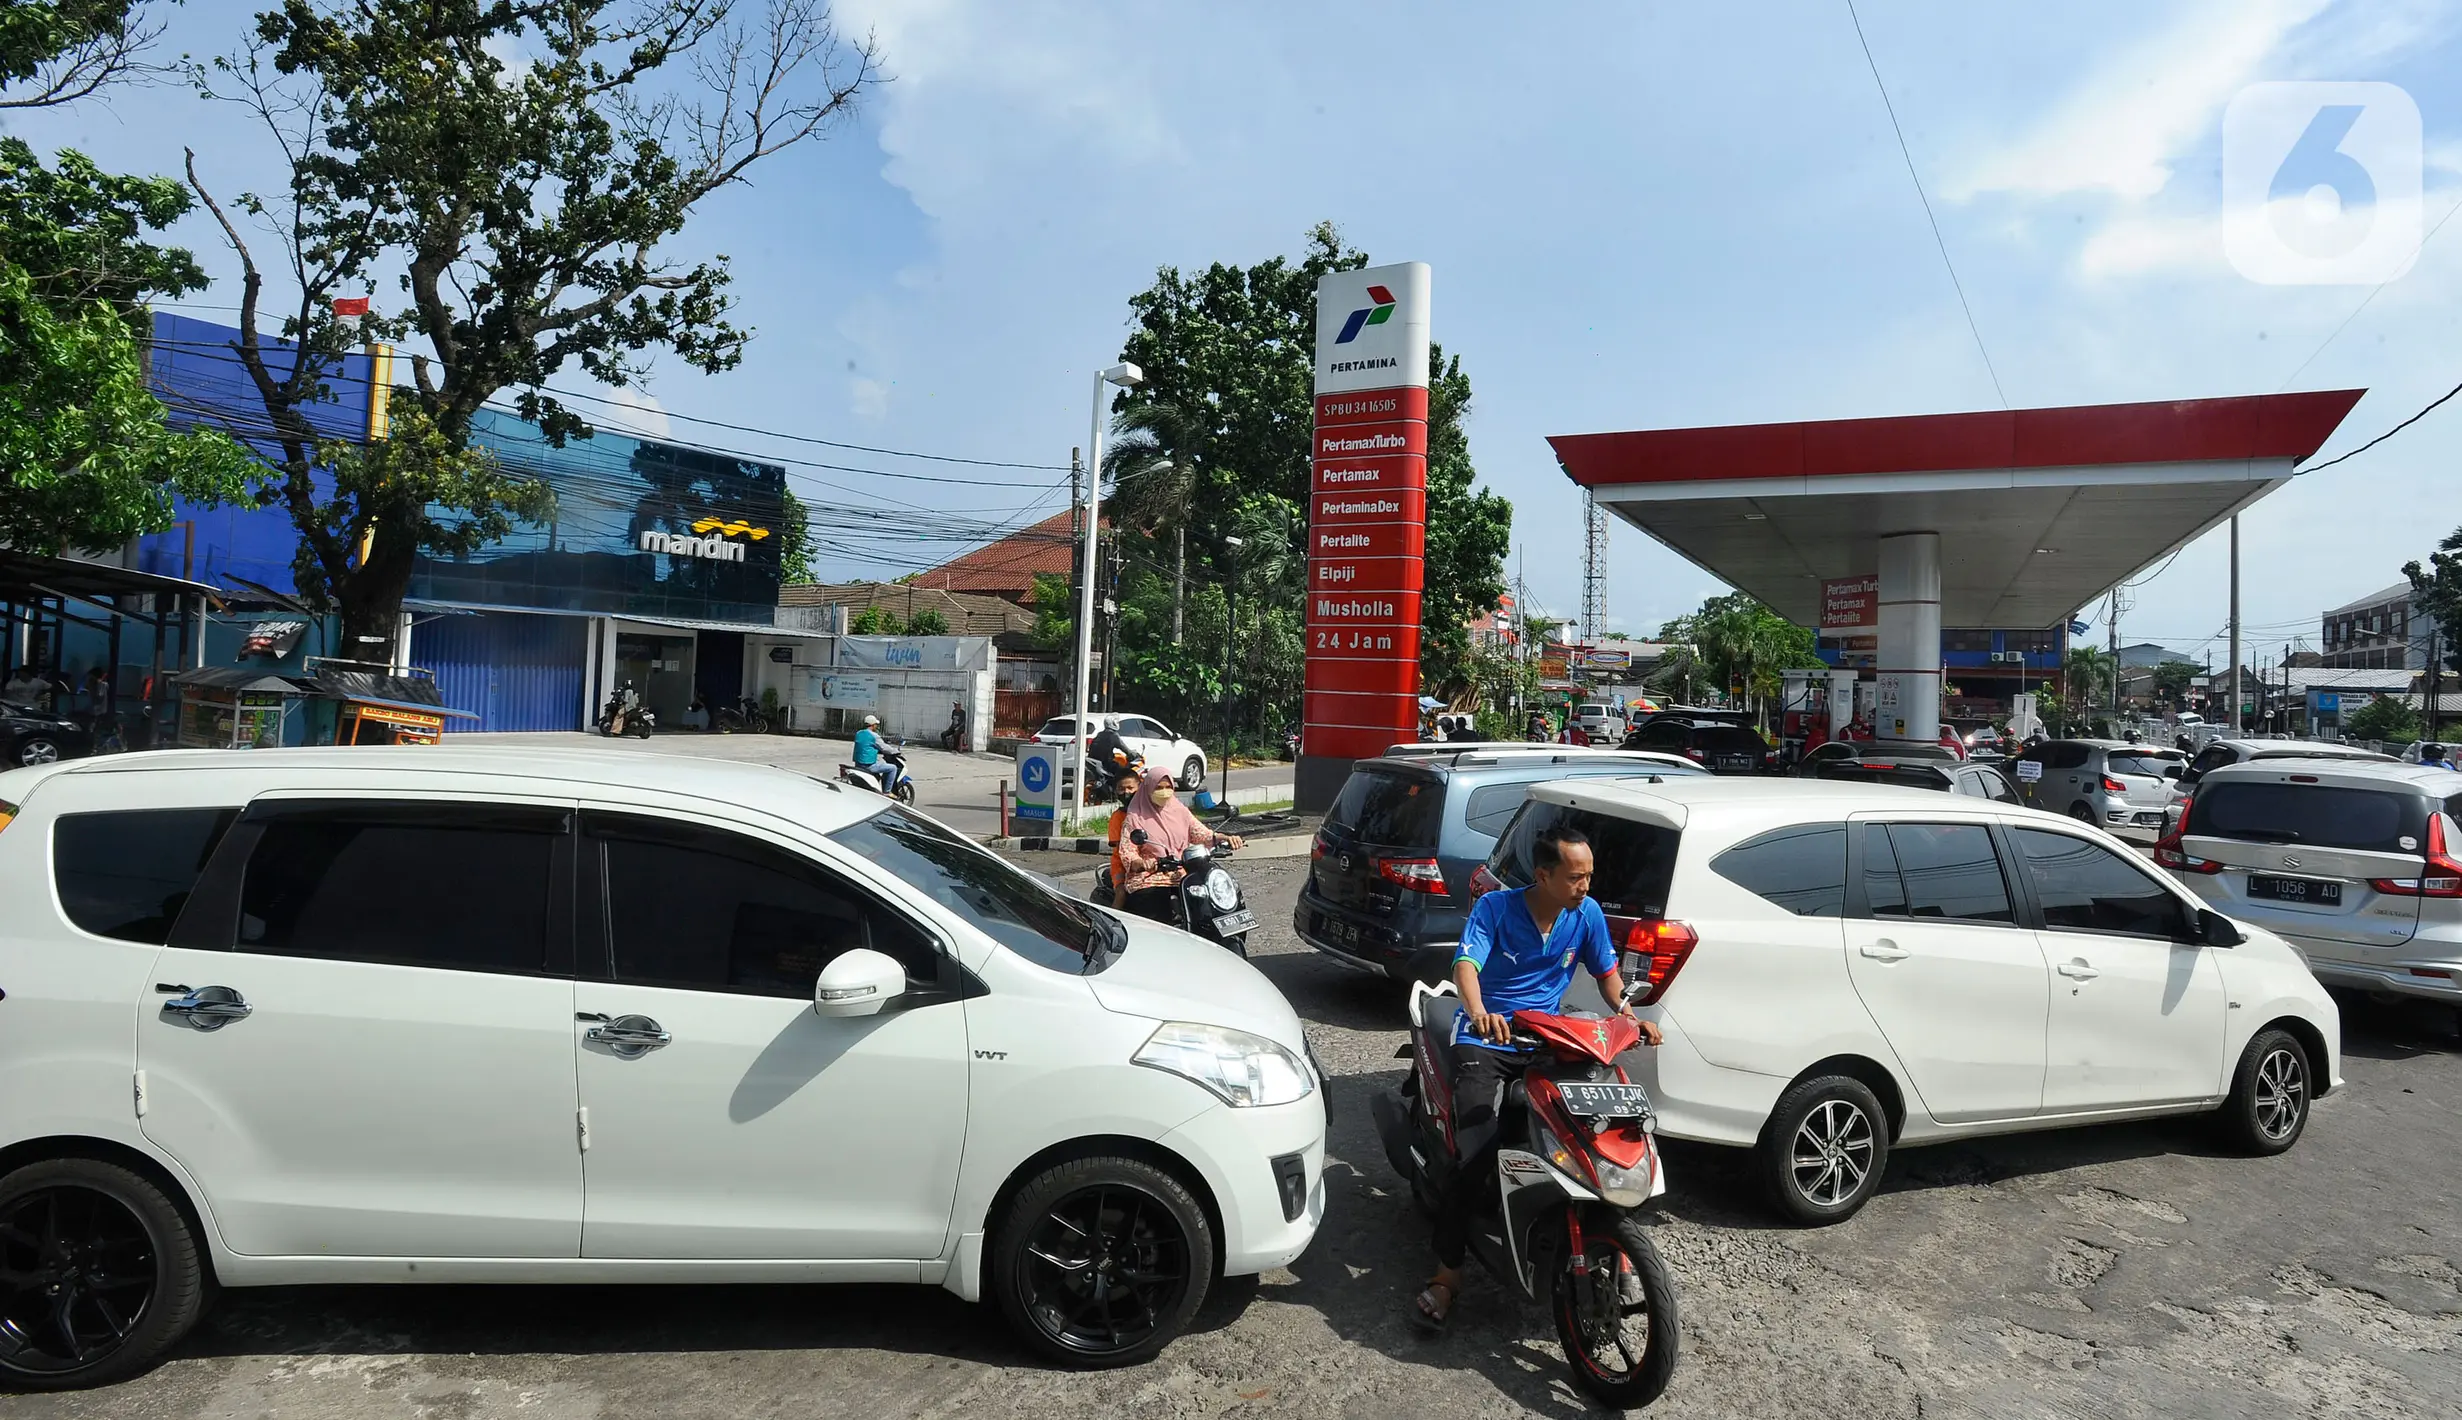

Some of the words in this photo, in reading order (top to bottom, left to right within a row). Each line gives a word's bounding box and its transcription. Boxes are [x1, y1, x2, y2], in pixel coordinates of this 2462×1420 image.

[1331, 357, 1398, 374] PERTAMINA
[1324, 403, 1352, 416] SPBU
[1355, 401, 1366, 414] 34
[1369, 399, 1397, 413] 16505
[1322, 434, 1406, 452] PertamaxTurbo
[1323, 468, 1380, 483] Pertamax
[1322, 500, 1400, 515] PertaminaDex
[641, 531, 745, 562] mandiri
[1320, 534, 1371, 548] Pertalite
[1319, 566, 1356, 582] Elpiji
[1317, 600, 1394, 617] Musholla
[1827, 598, 1866, 610] Pertamax
[1827, 611, 1861, 624] Pertalite
[1317, 633, 1340, 649] 24
[1349, 633, 1392, 649] Jam
[1023, 809, 1047, 817] MASUK
[2250, 877, 2258, 890] L
[2275, 880, 2306, 894] 1056
[2321, 884, 2338, 898] AD
[974, 1050, 1008, 1060] VVT
[1562, 1086, 1573, 1099] B
[1580, 1087, 1616, 1101] 6511
[1617, 1087, 1646, 1101] ZJK
